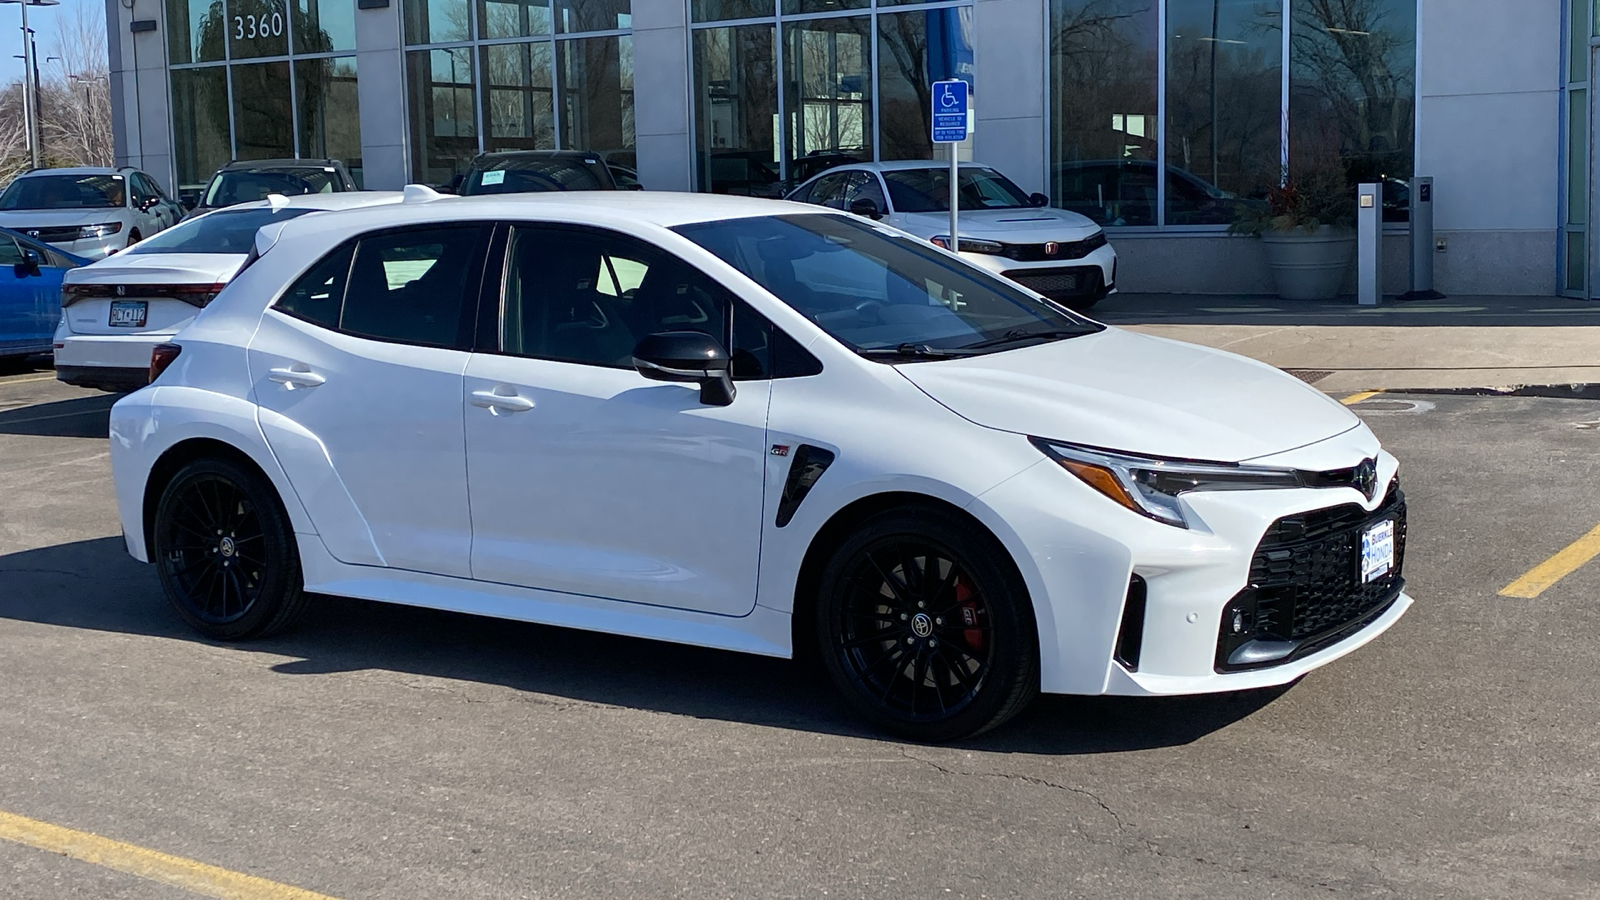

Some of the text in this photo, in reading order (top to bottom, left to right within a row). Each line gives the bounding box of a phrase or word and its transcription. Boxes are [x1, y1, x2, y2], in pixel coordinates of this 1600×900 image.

[234, 12, 282, 39] 3360
[1372, 528, 1393, 545] BUERKLE
[1372, 541, 1393, 565] HONDA
